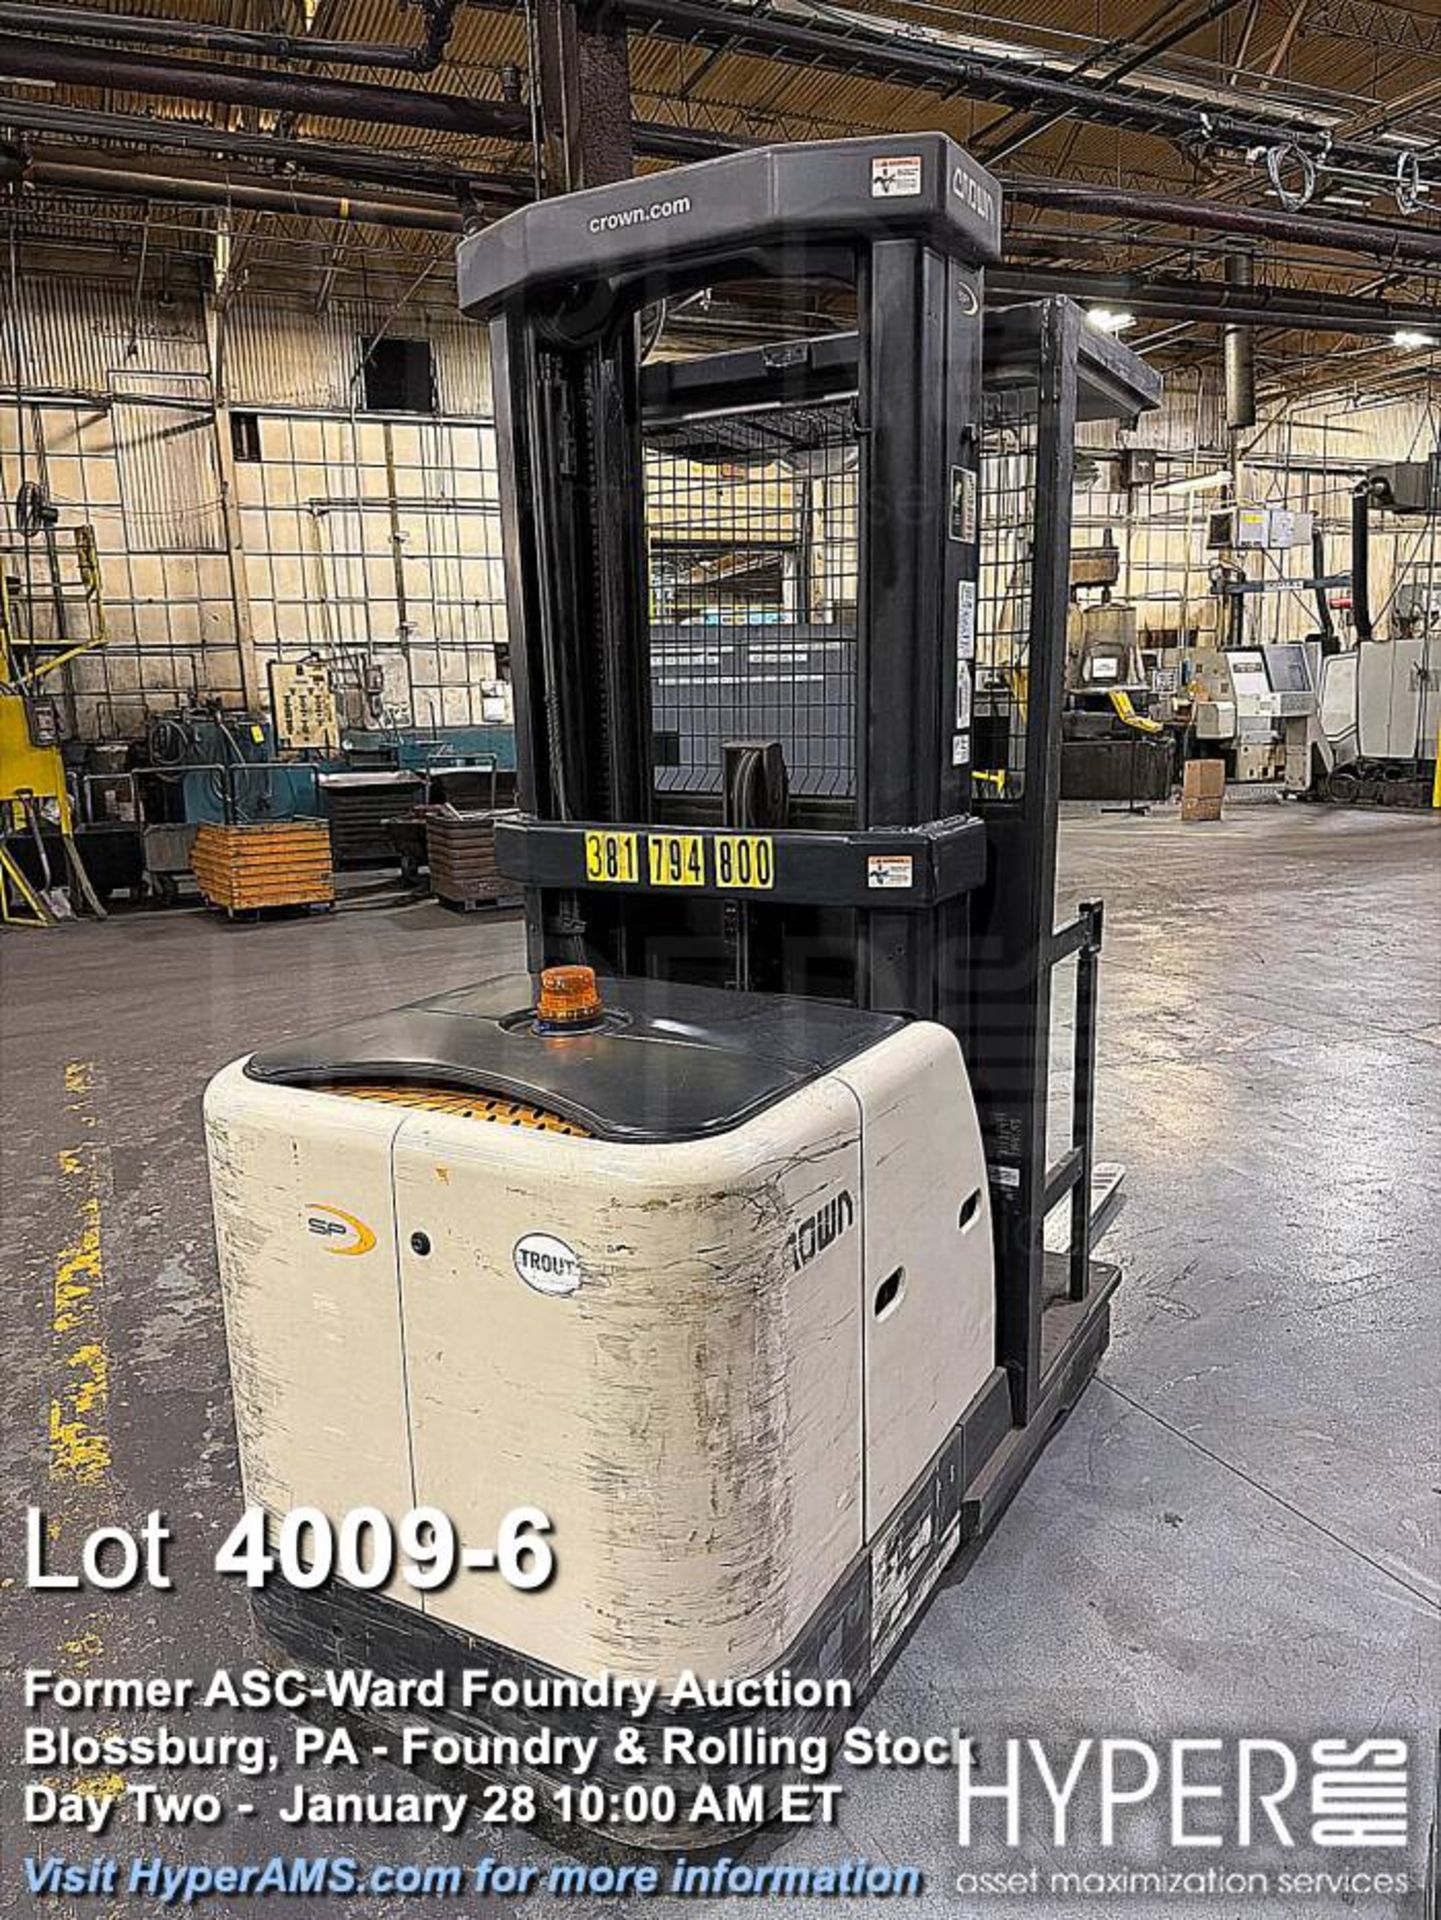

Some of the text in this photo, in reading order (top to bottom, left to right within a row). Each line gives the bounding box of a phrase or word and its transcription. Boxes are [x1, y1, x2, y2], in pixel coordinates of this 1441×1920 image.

[589, 196, 692, 234] crown.com
[587, 835, 771, 886] 381 794 800
[308, 1217, 347, 1236] SP
[518, 1248, 575, 1276] TROUT
